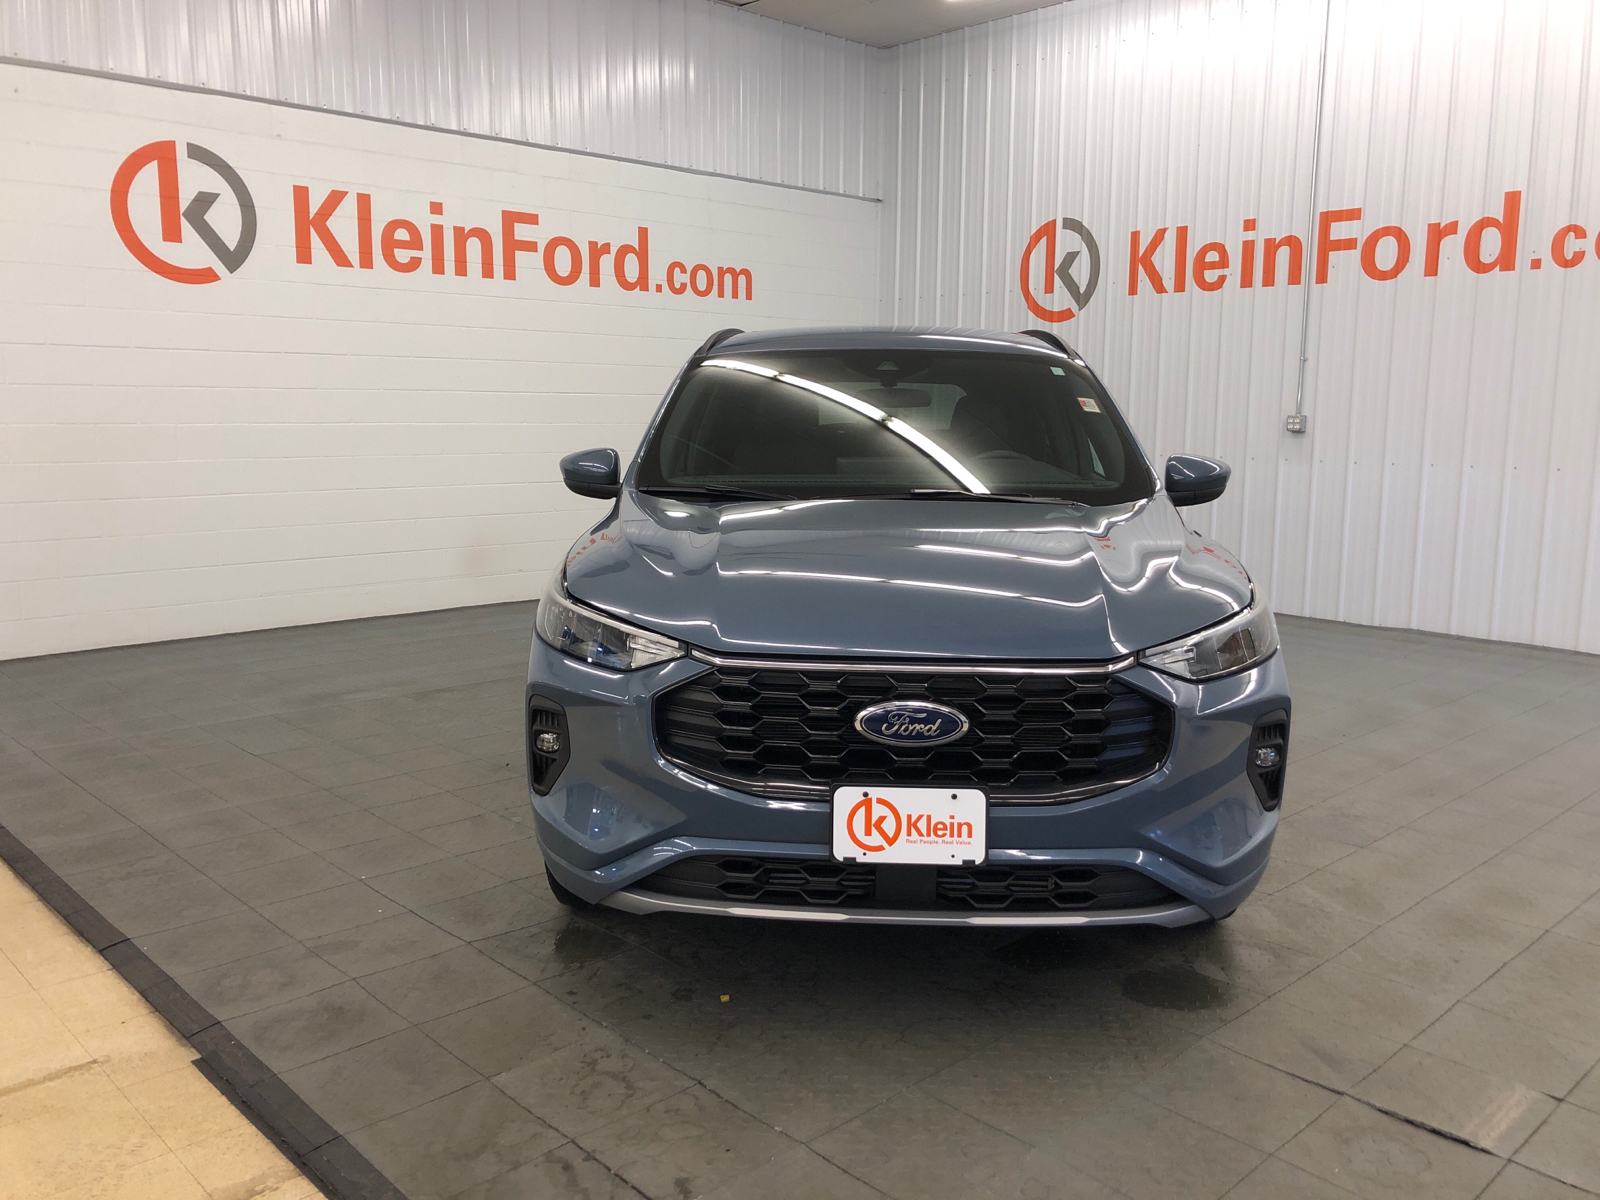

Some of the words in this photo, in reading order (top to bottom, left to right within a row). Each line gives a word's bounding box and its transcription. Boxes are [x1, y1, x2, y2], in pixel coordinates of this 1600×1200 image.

[293, 185, 753, 301] KleinFord.com
[1128, 190, 1600, 296] KleinFord.c
[882, 711, 942, 736] Ford
[906, 814, 973, 839] Klein
